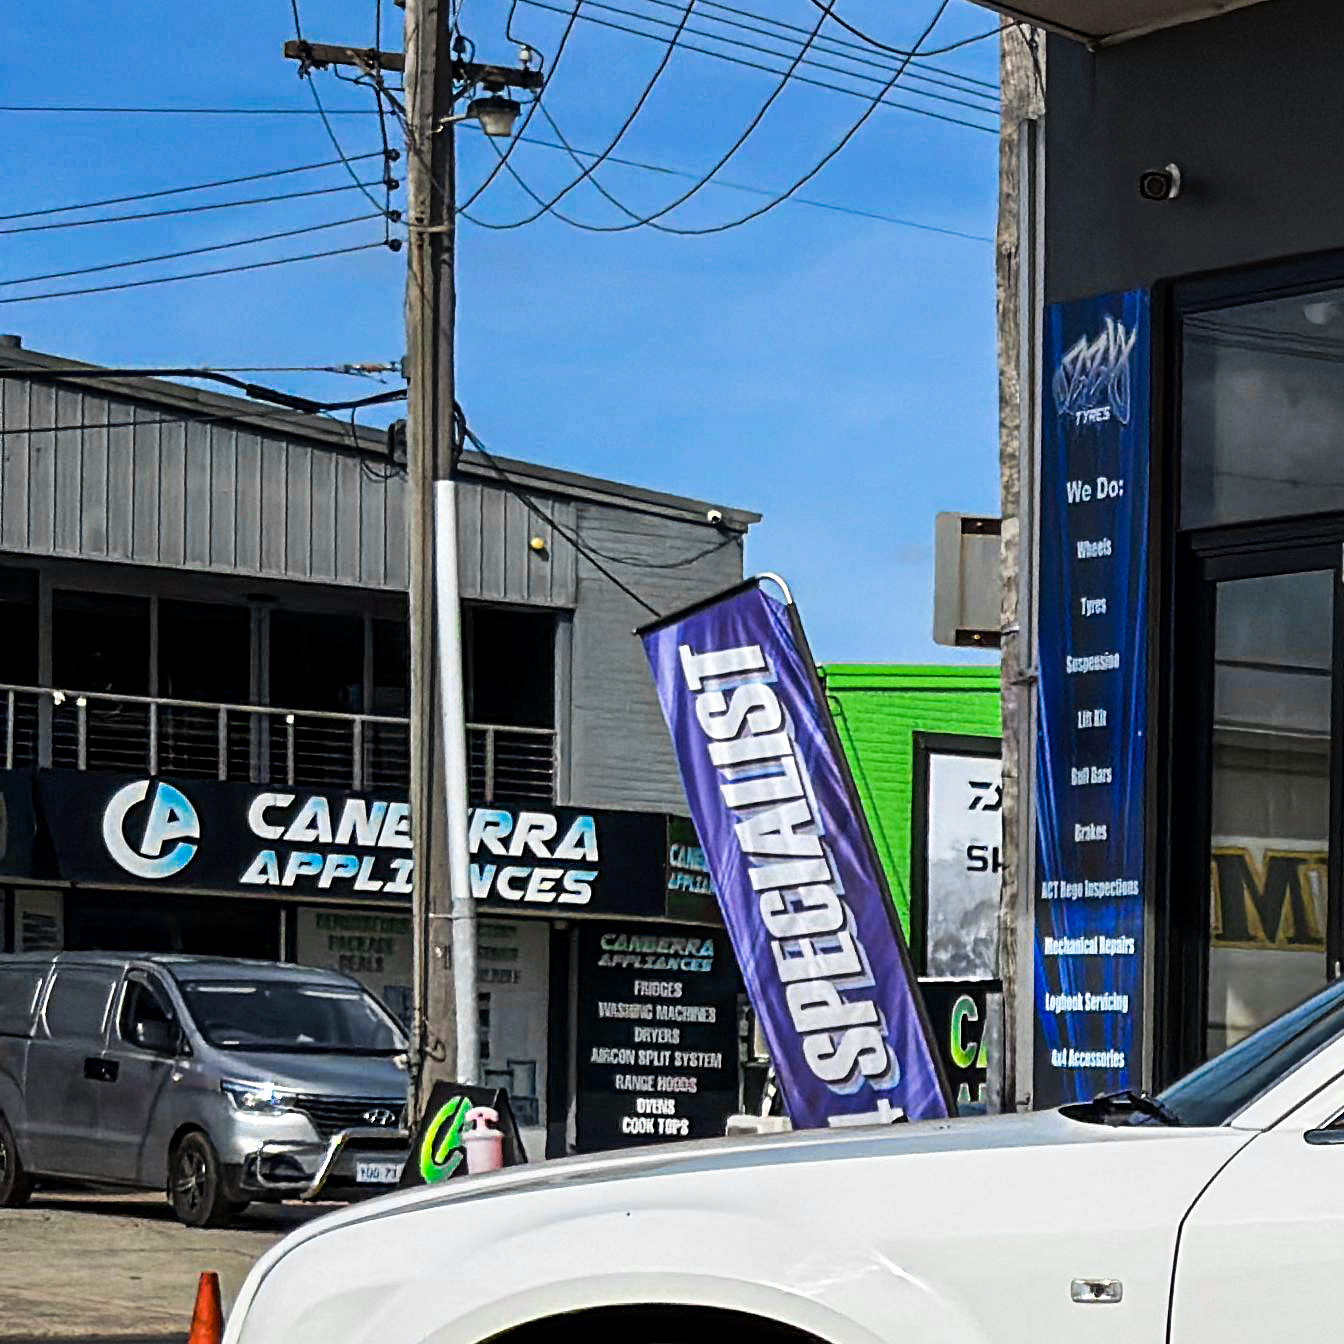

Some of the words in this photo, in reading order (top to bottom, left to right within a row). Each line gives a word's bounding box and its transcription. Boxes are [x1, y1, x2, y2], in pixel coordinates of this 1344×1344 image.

[1075, 405, 1111, 426] TYRES
[1066, 479, 1092, 504] We
[1096, 476, 1124, 500] Do:
[1076, 537, 1112, 559] Wheels
[1080, 596, 1107, 617] Tyres
[1077, 709, 1092, 729] Lift
[1093, 708, 1107, 728] Kit
[1091, 766, 1112, 785] Bars
[246, 792, 599, 863] CANBRRA
[1074, 823, 1107, 843] Brakes
[679, 643, 895, 1086] SPECIALIST
[239, 849, 599, 905] APPLINCES
[1041, 880, 1059, 899] ACT
[1061, 880, 1083, 901] Rego
[1084, 878, 1139, 899] Inspections
[600, 933, 715, 957] CANBERRA
[1044, 935, 1098, 955] Mechanical
[1099, 935, 1135, 957] Repairs
[597, 953, 713, 972] APPLIANCES
[634, 980, 683, 998] FRIDGES
[598, 1001, 653, 1020] WASHING
[656, 1004, 717, 1023] MACHINES
[1045, 991, 1083, 1014] Logbook
[1084, 991, 1129, 1014] Servicing
[634, 1026, 680, 1044] DRYERS
[590, 1047, 635, 1065] AIRCON
[638, 1049, 671, 1067] SPLIT
[674, 1051, 722, 1069] SYSTEM
[1051, 1048, 1067, 1068] 4x4
[1068, 1048, 1125, 1068] Accessories
[615, 1074, 655, 1092] RANGE
[657, 1076, 697, 1093] HOODS
[636, 1097, 675, 1115] OVENS
[622, 1116, 654, 1134] COOK
[657, 1117, 689, 1136] TOPS
